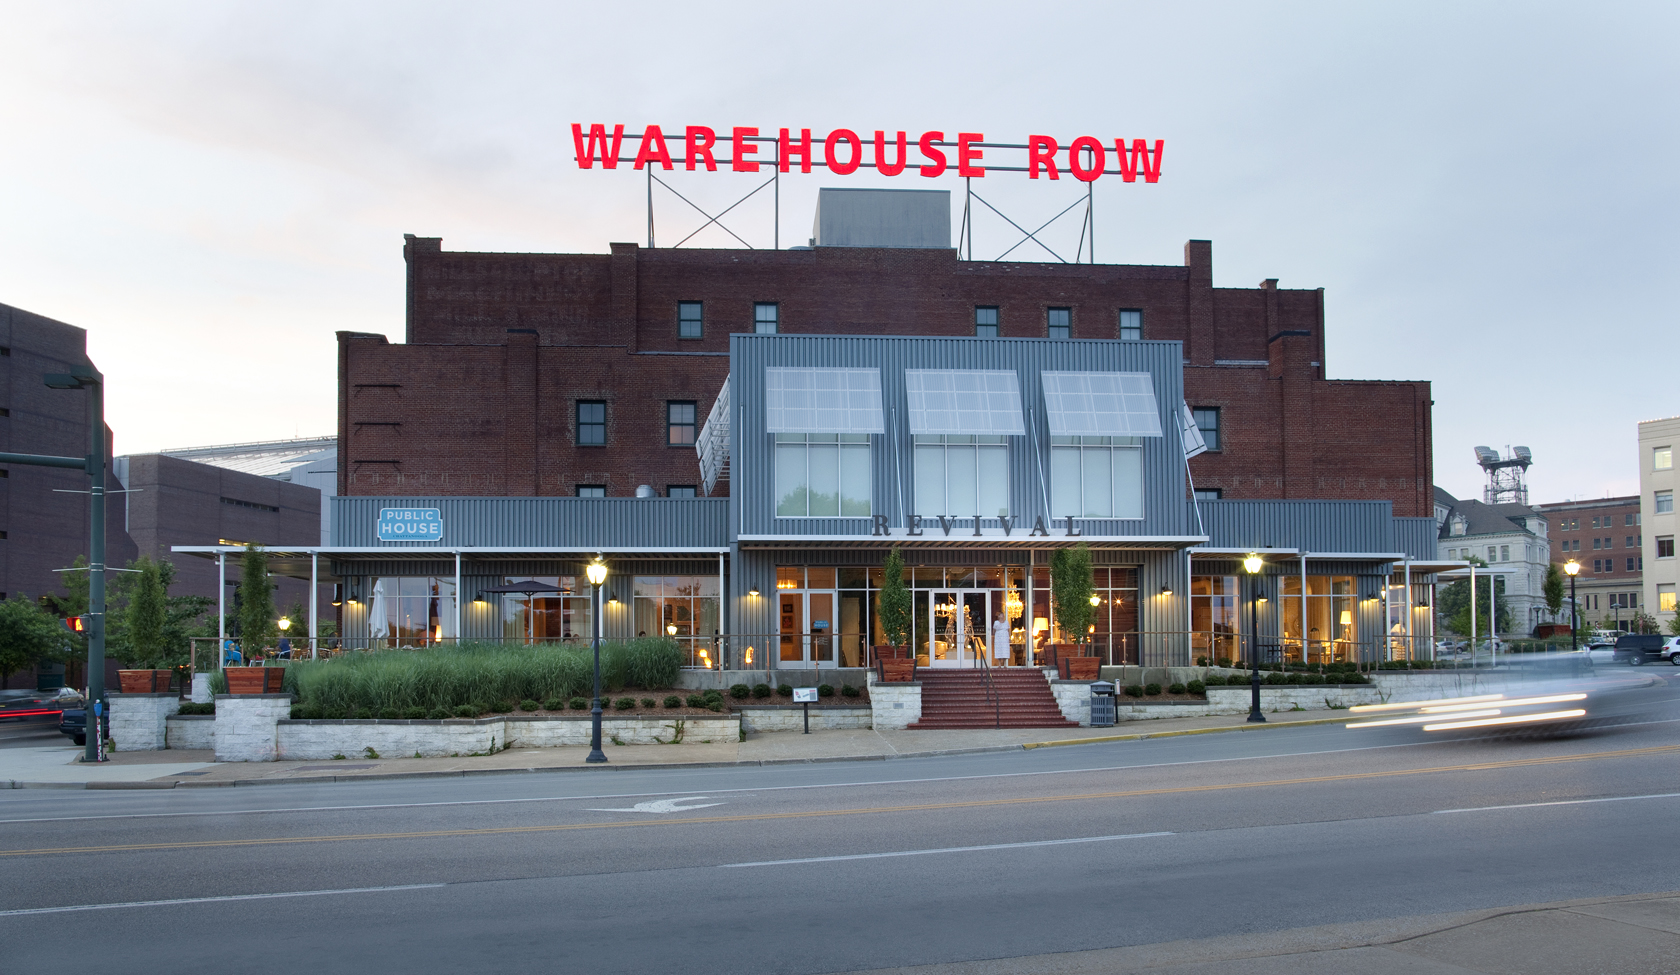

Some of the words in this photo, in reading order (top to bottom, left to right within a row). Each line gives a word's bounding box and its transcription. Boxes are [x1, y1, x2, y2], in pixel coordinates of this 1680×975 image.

[571, 123, 987, 178] WAREHOUSE
[1028, 134, 1165, 184] ROW
[387, 511, 433, 520] PUBLIC
[382, 522, 438, 533] HOUSE
[872, 514, 1081, 537] REVIVAL
